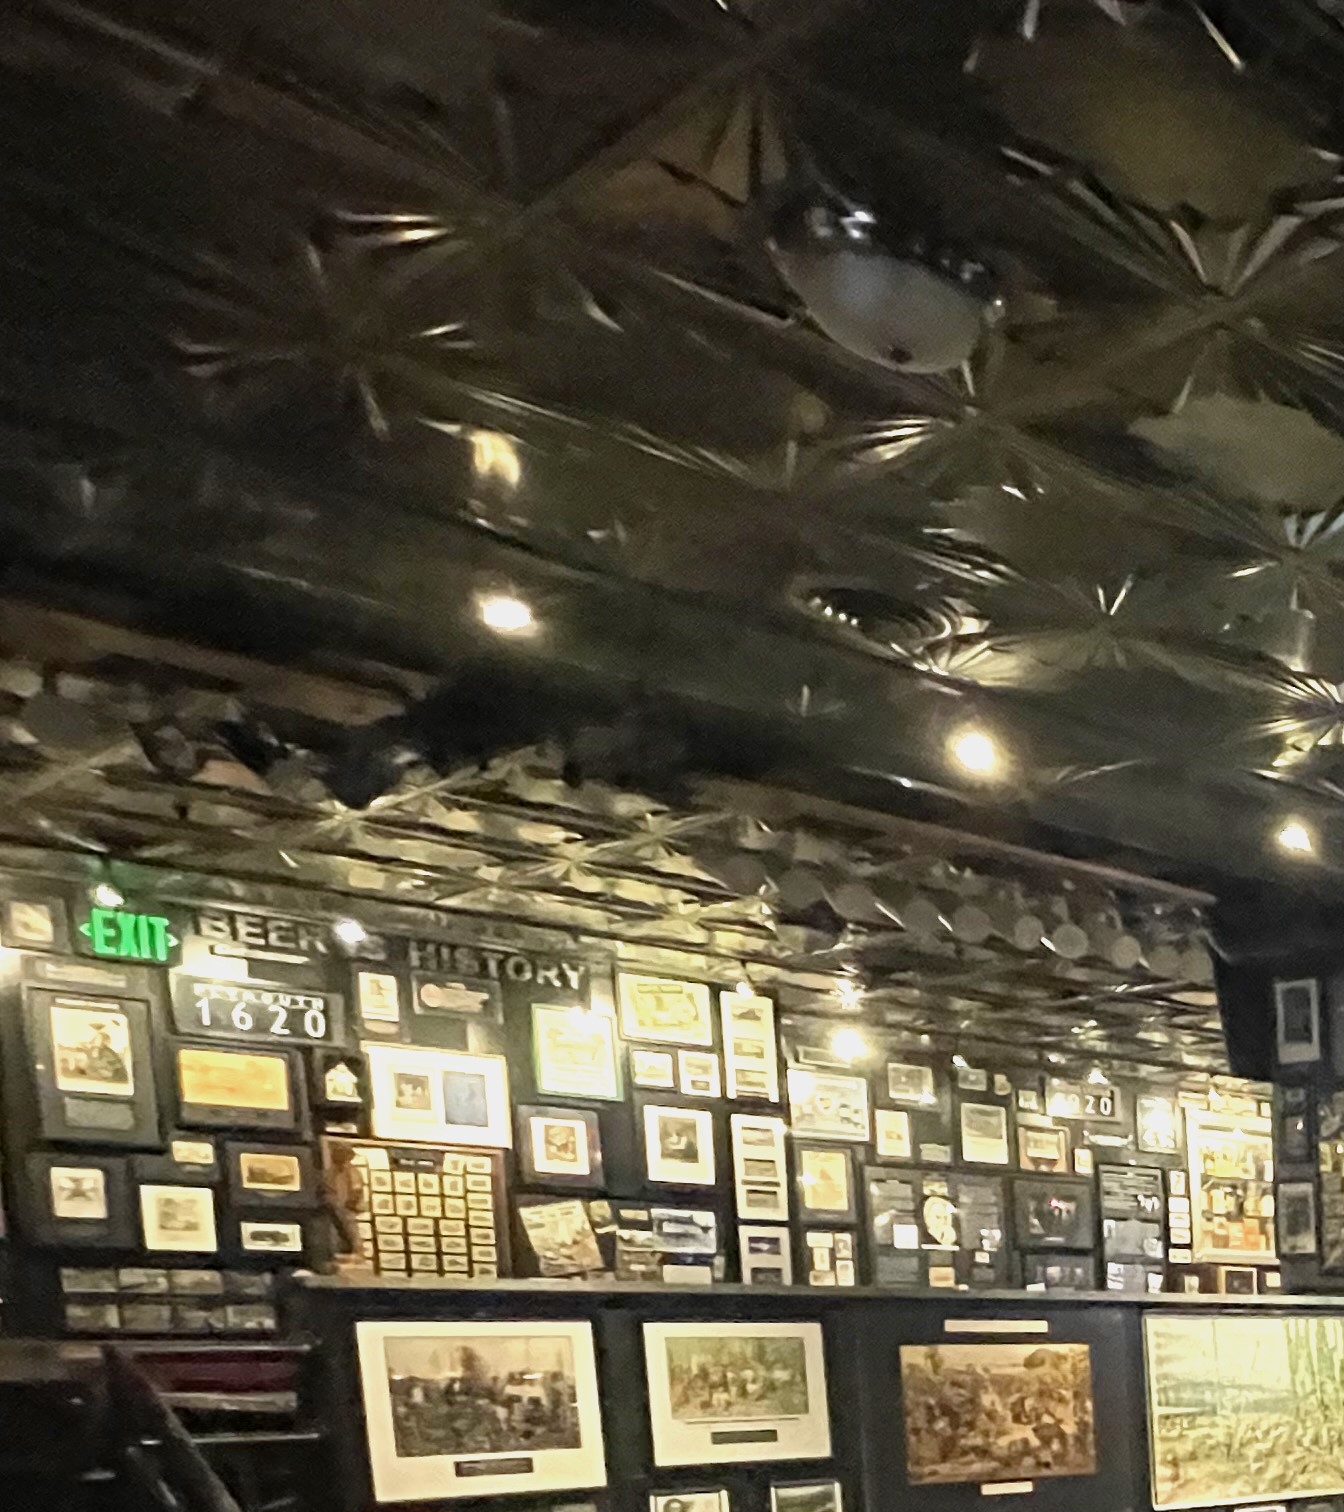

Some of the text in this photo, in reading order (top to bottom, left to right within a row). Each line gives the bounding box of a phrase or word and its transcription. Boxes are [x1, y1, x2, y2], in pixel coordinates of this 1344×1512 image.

[91, 907, 169, 962] EXIT
[199, 911, 328, 954] BEER
[408, 940, 586, 990] HISTORY
[195, 997, 326, 1039] 1620
